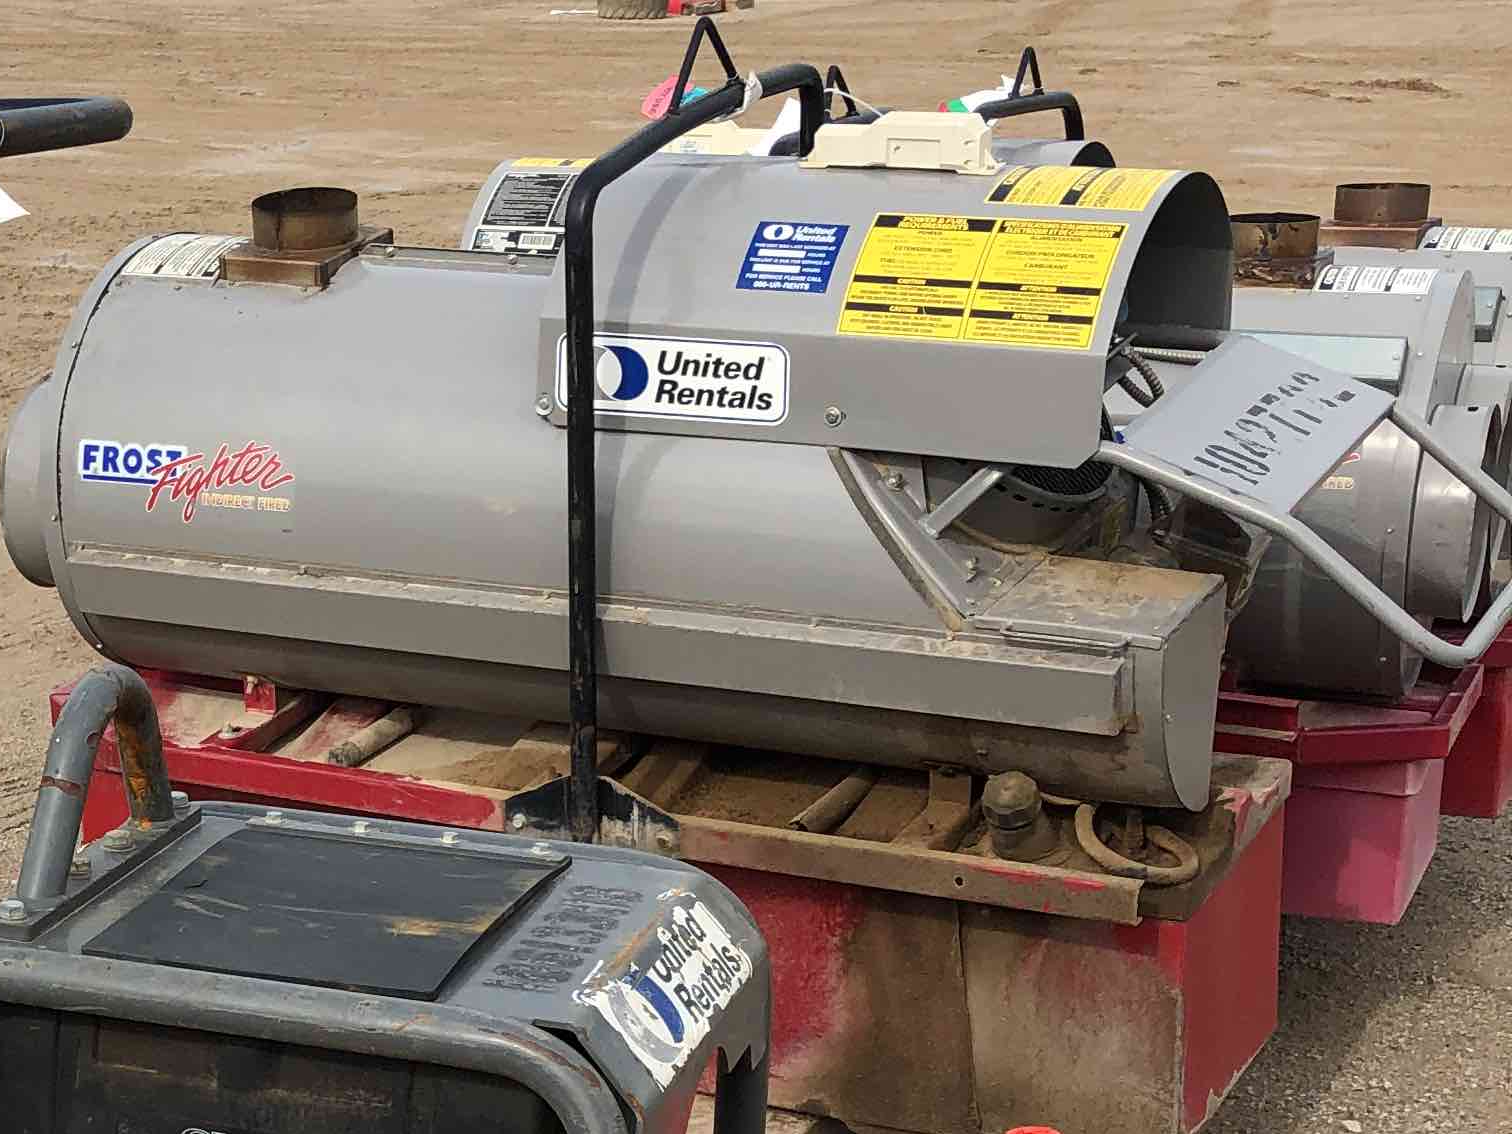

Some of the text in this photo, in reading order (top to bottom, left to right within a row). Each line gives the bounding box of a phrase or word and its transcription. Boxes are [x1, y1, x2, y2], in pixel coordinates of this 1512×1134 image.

[654, 379, 773, 411] Rentals
[657, 350, 765, 381] United
[83, 441, 294, 522] FROST Fighter
[651, 913, 707, 983] United
[673, 943, 742, 1023] Rentals
